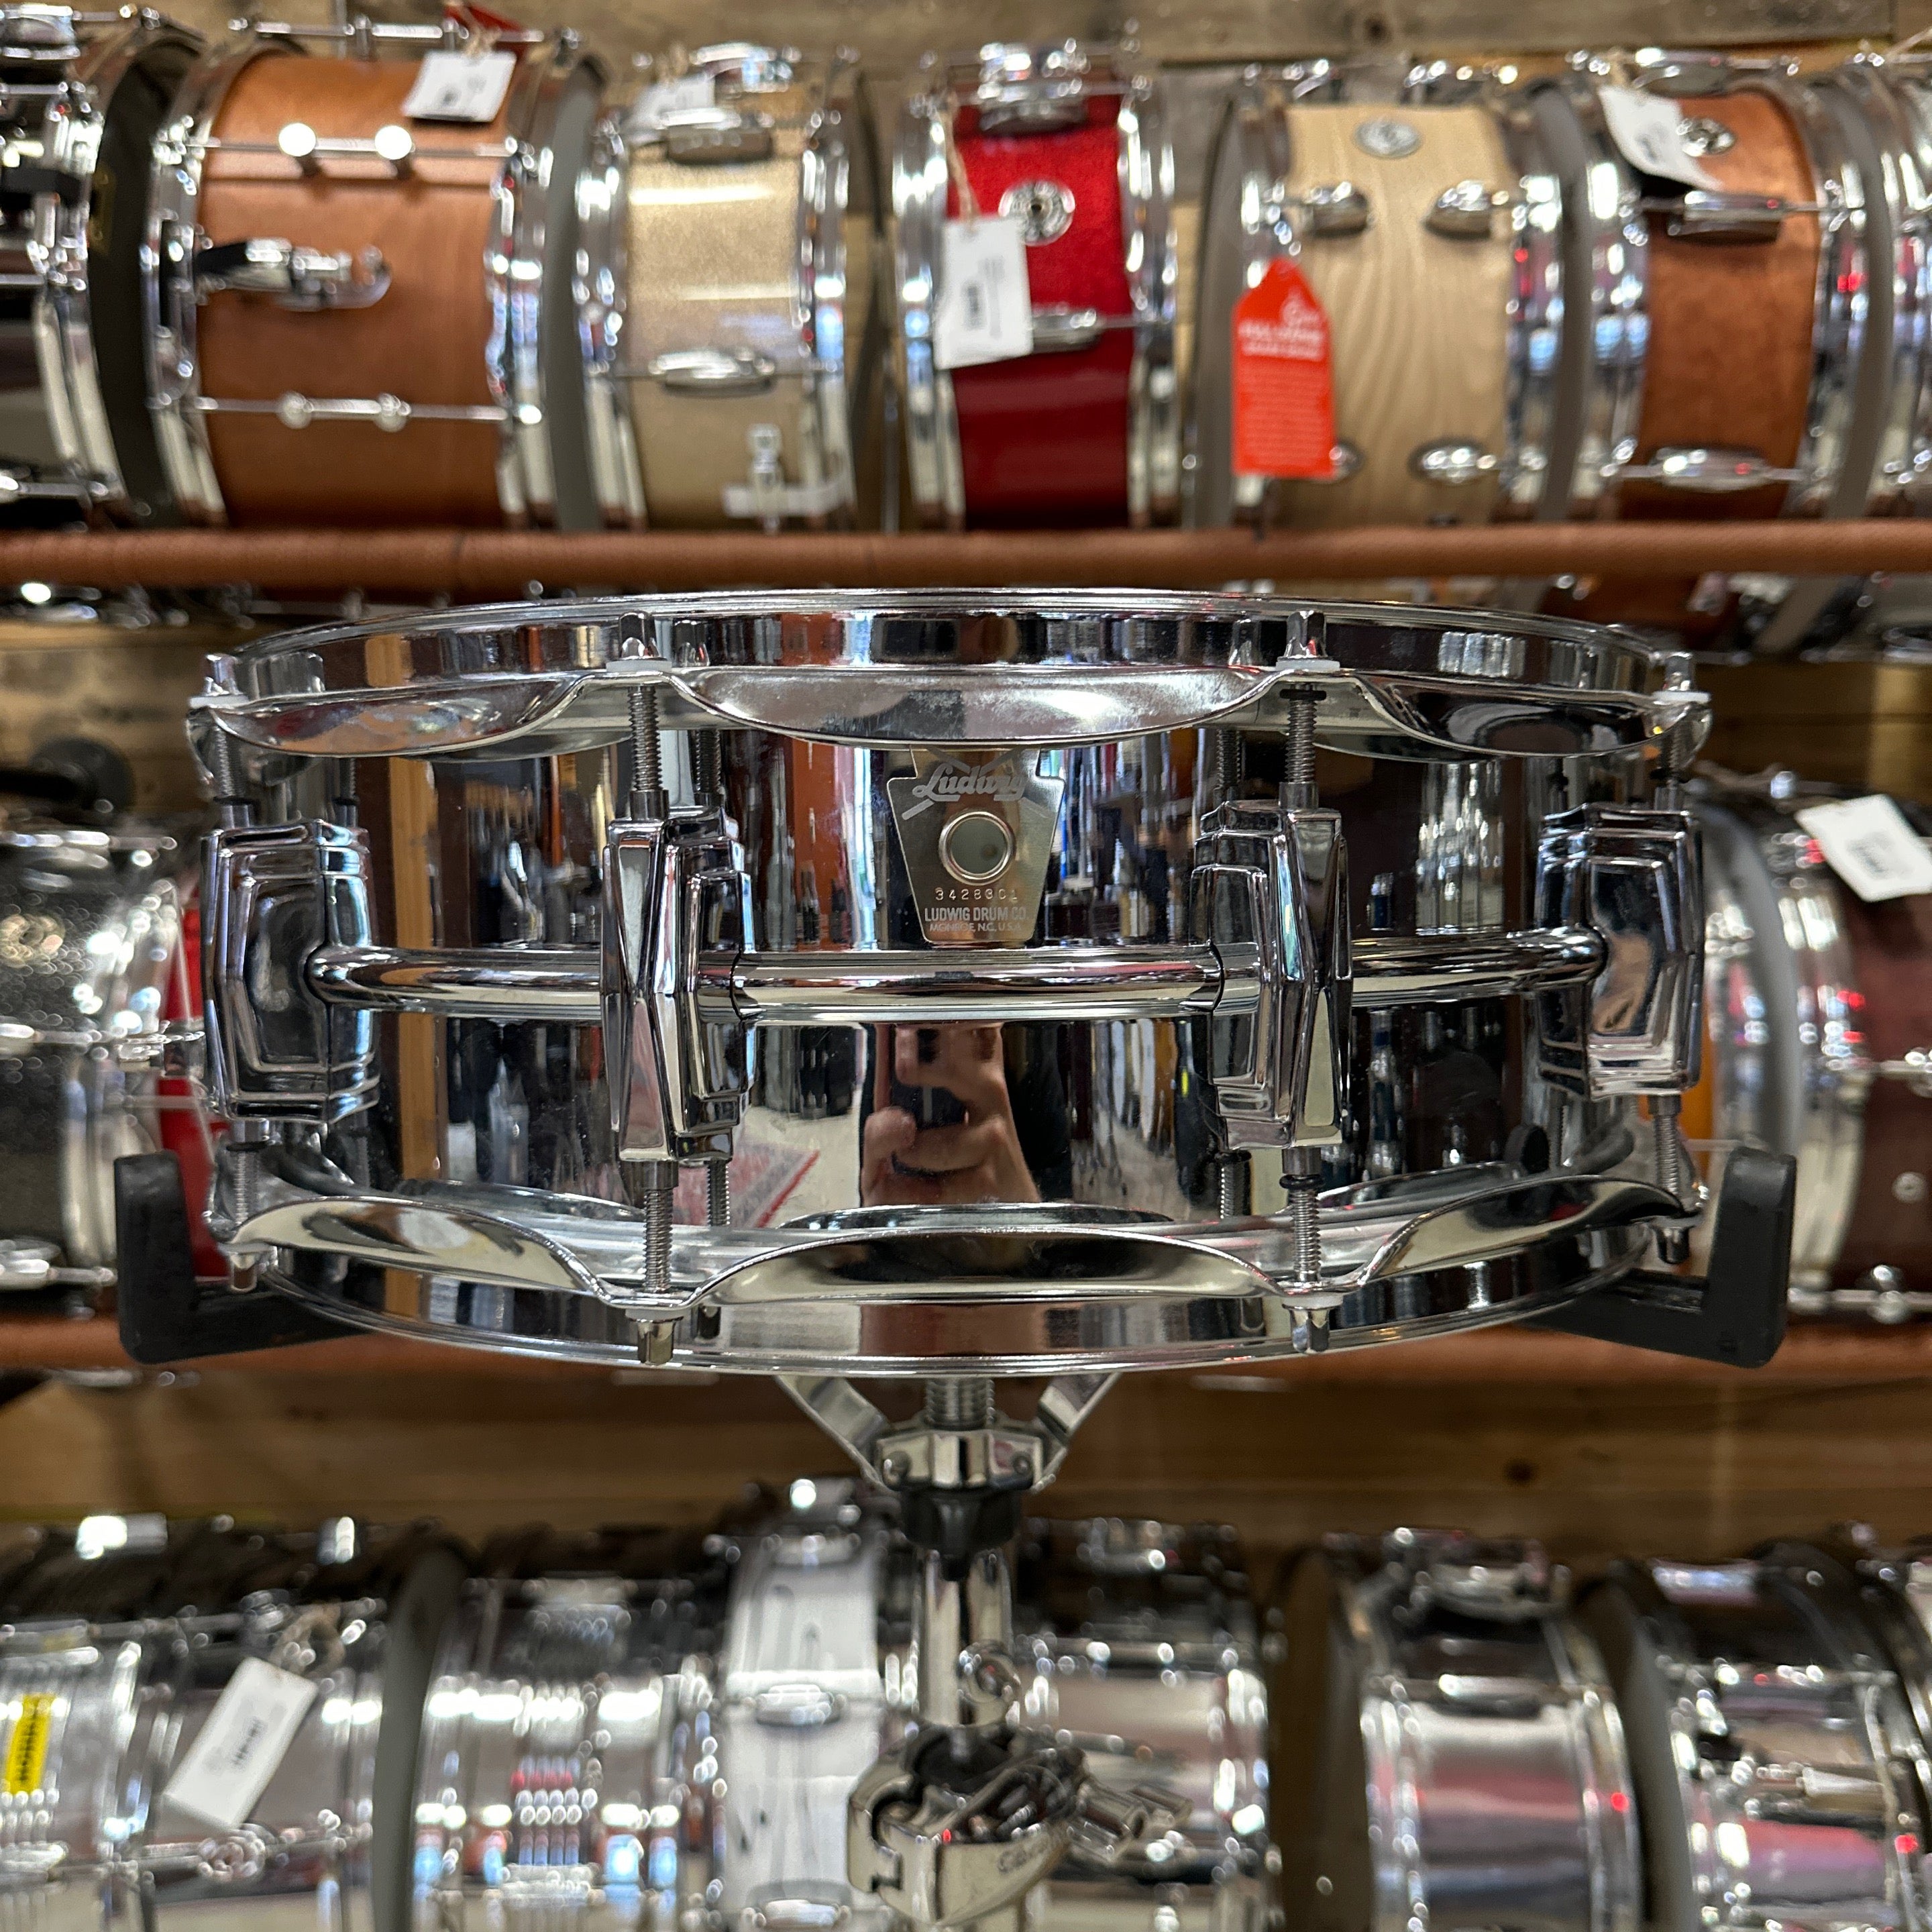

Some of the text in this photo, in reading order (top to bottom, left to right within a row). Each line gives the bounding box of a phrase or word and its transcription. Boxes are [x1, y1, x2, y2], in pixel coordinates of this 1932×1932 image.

[912, 763, 1026, 802] Ludwig
[924, 907, 971, 922] LUDWIG
[973, 907, 1008, 922] DRUM
